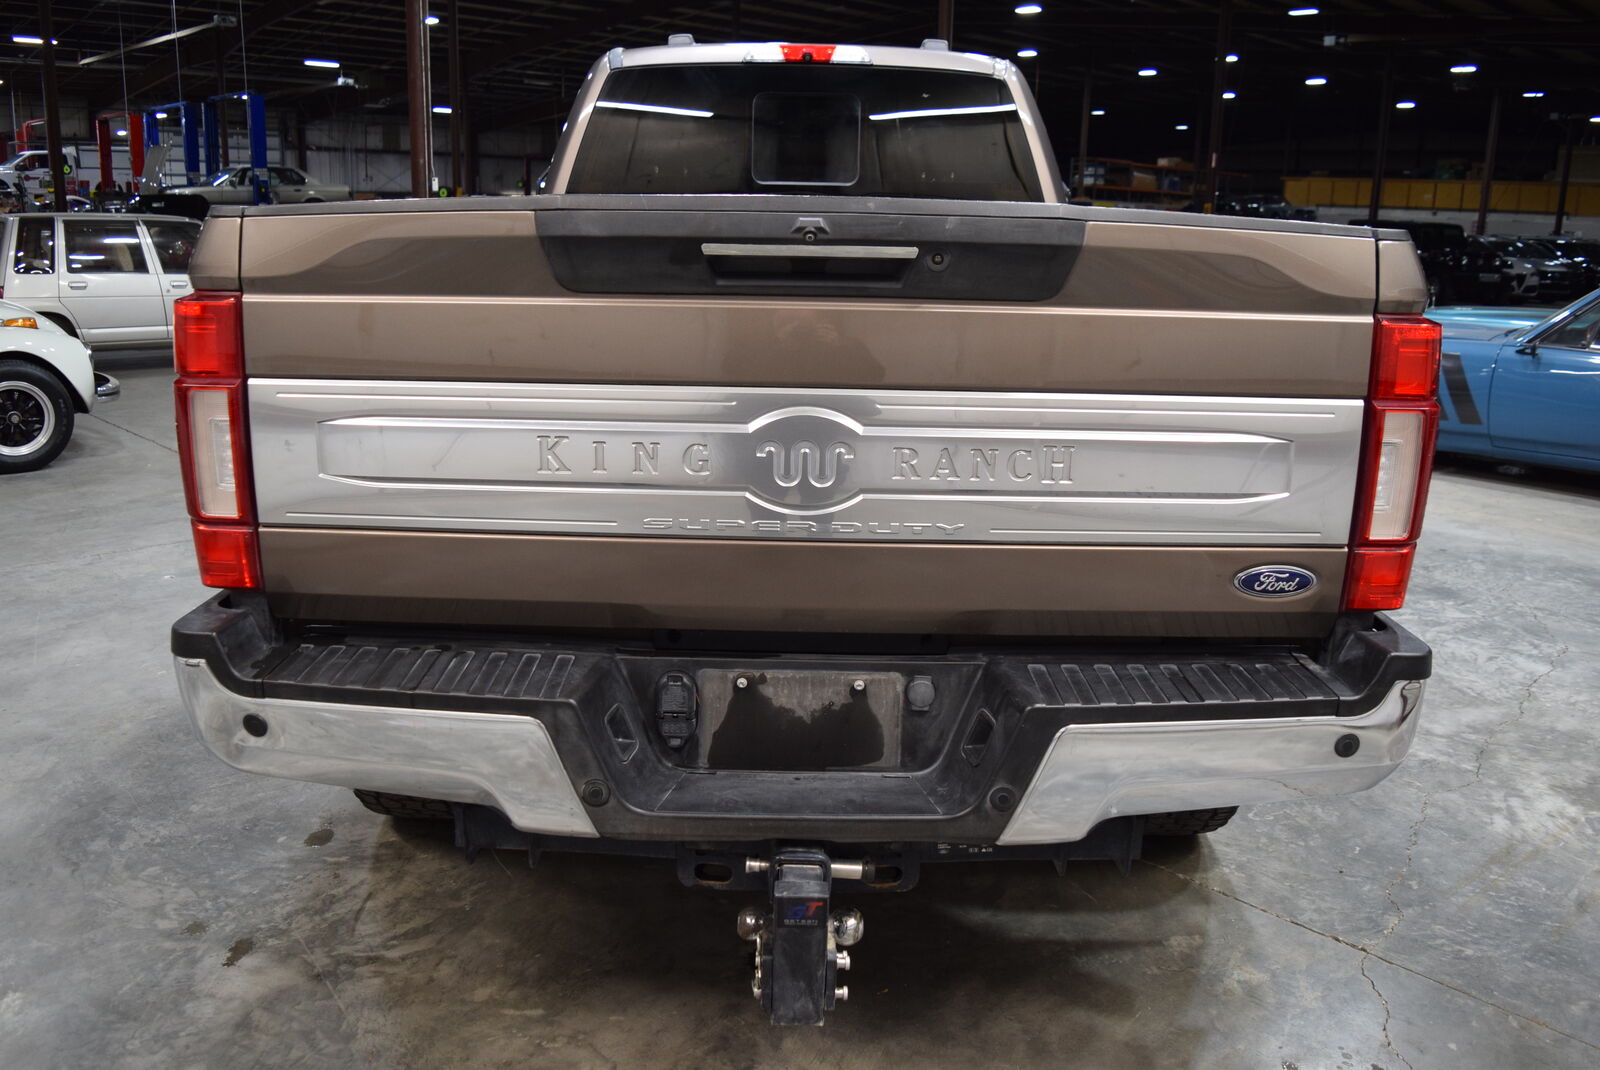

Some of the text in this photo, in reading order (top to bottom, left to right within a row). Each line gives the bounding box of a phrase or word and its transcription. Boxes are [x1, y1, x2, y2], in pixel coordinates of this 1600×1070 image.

[537, 435, 1075, 484] KING RANCH
[643, 517, 965, 535] SUPER DUTY
[1254, 572, 1300, 591] Ford
